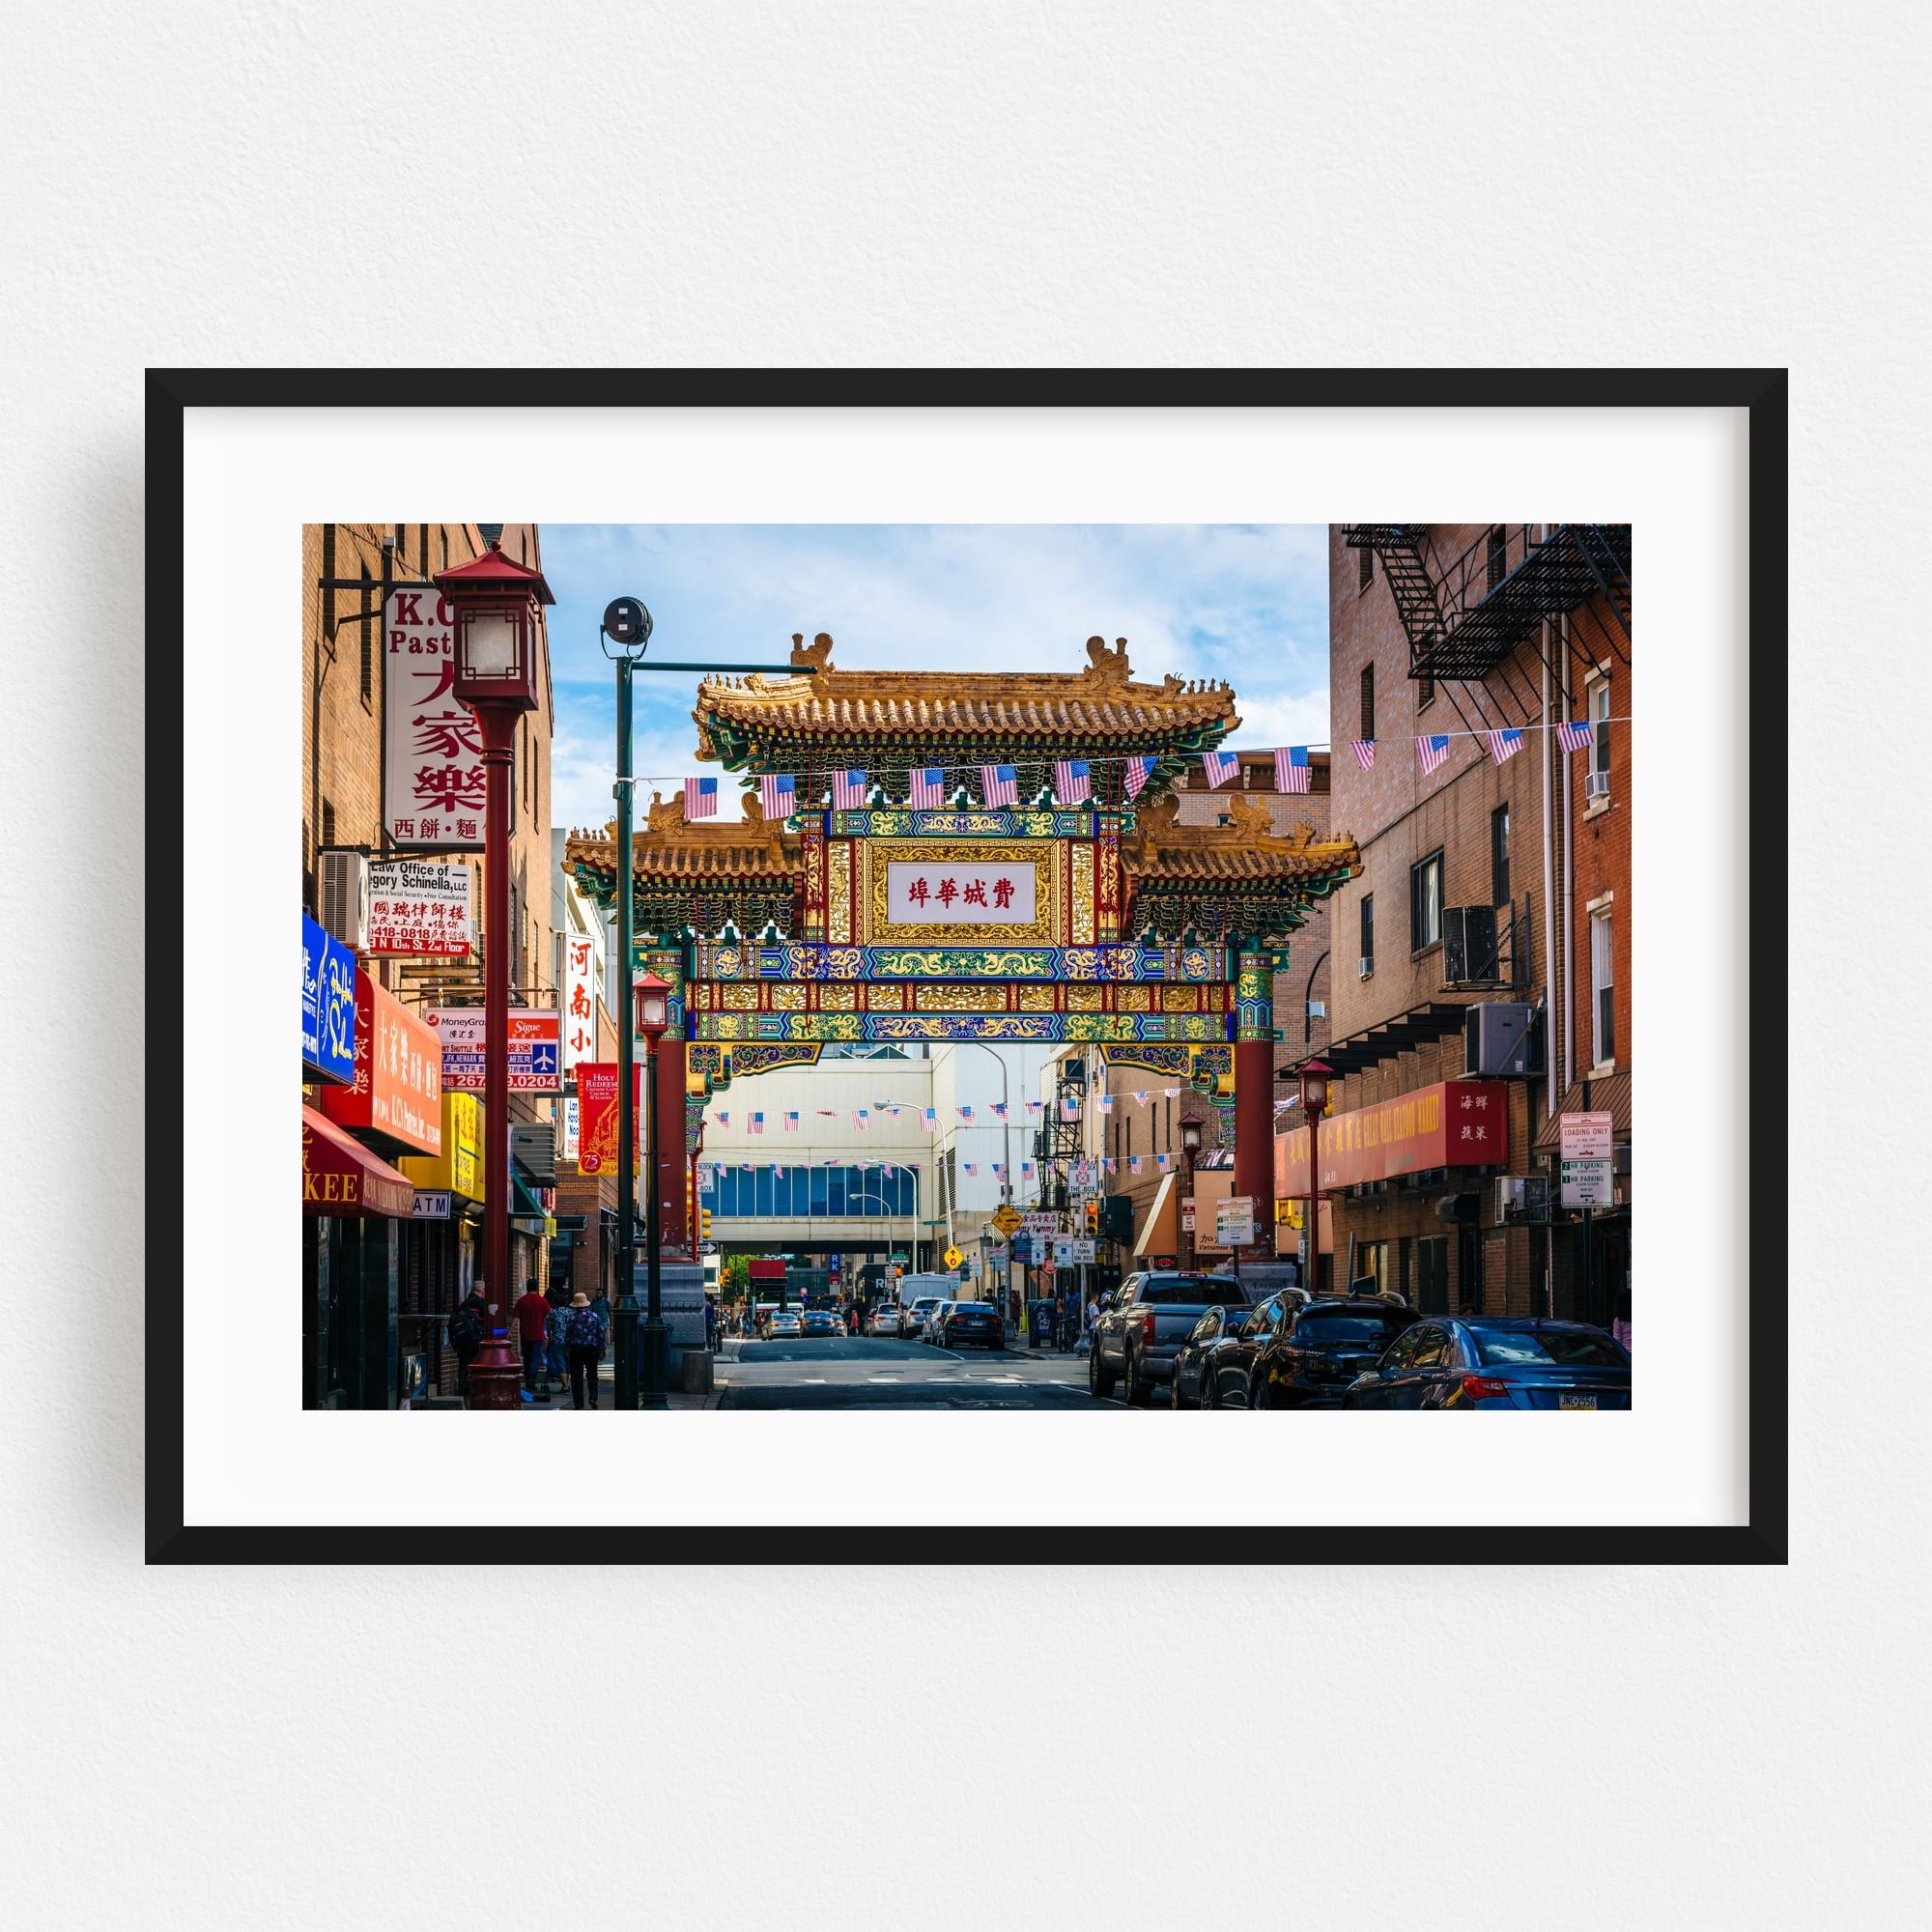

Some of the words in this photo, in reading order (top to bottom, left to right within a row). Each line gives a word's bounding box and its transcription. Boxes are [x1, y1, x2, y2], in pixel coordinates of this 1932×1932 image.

[400, 863, 434, 875] Office
[438, 866, 449, 876] of
[402, 874, 453, 894] Schinella,
[454, 883, 468, 892] LLC
[380, 938, 386, 948] N
[412, 940, 425, 950] St.
[428, 941, 441, 951] 2nd
[444, 942, 465, 952] Floor
[514, 1021, 541, 1034] Sigue
[1564, 1128, 1590, 1137] LOADING
[584, 1154, 598, 1168] 75
[413, 1198, 445, 1213] ATM
